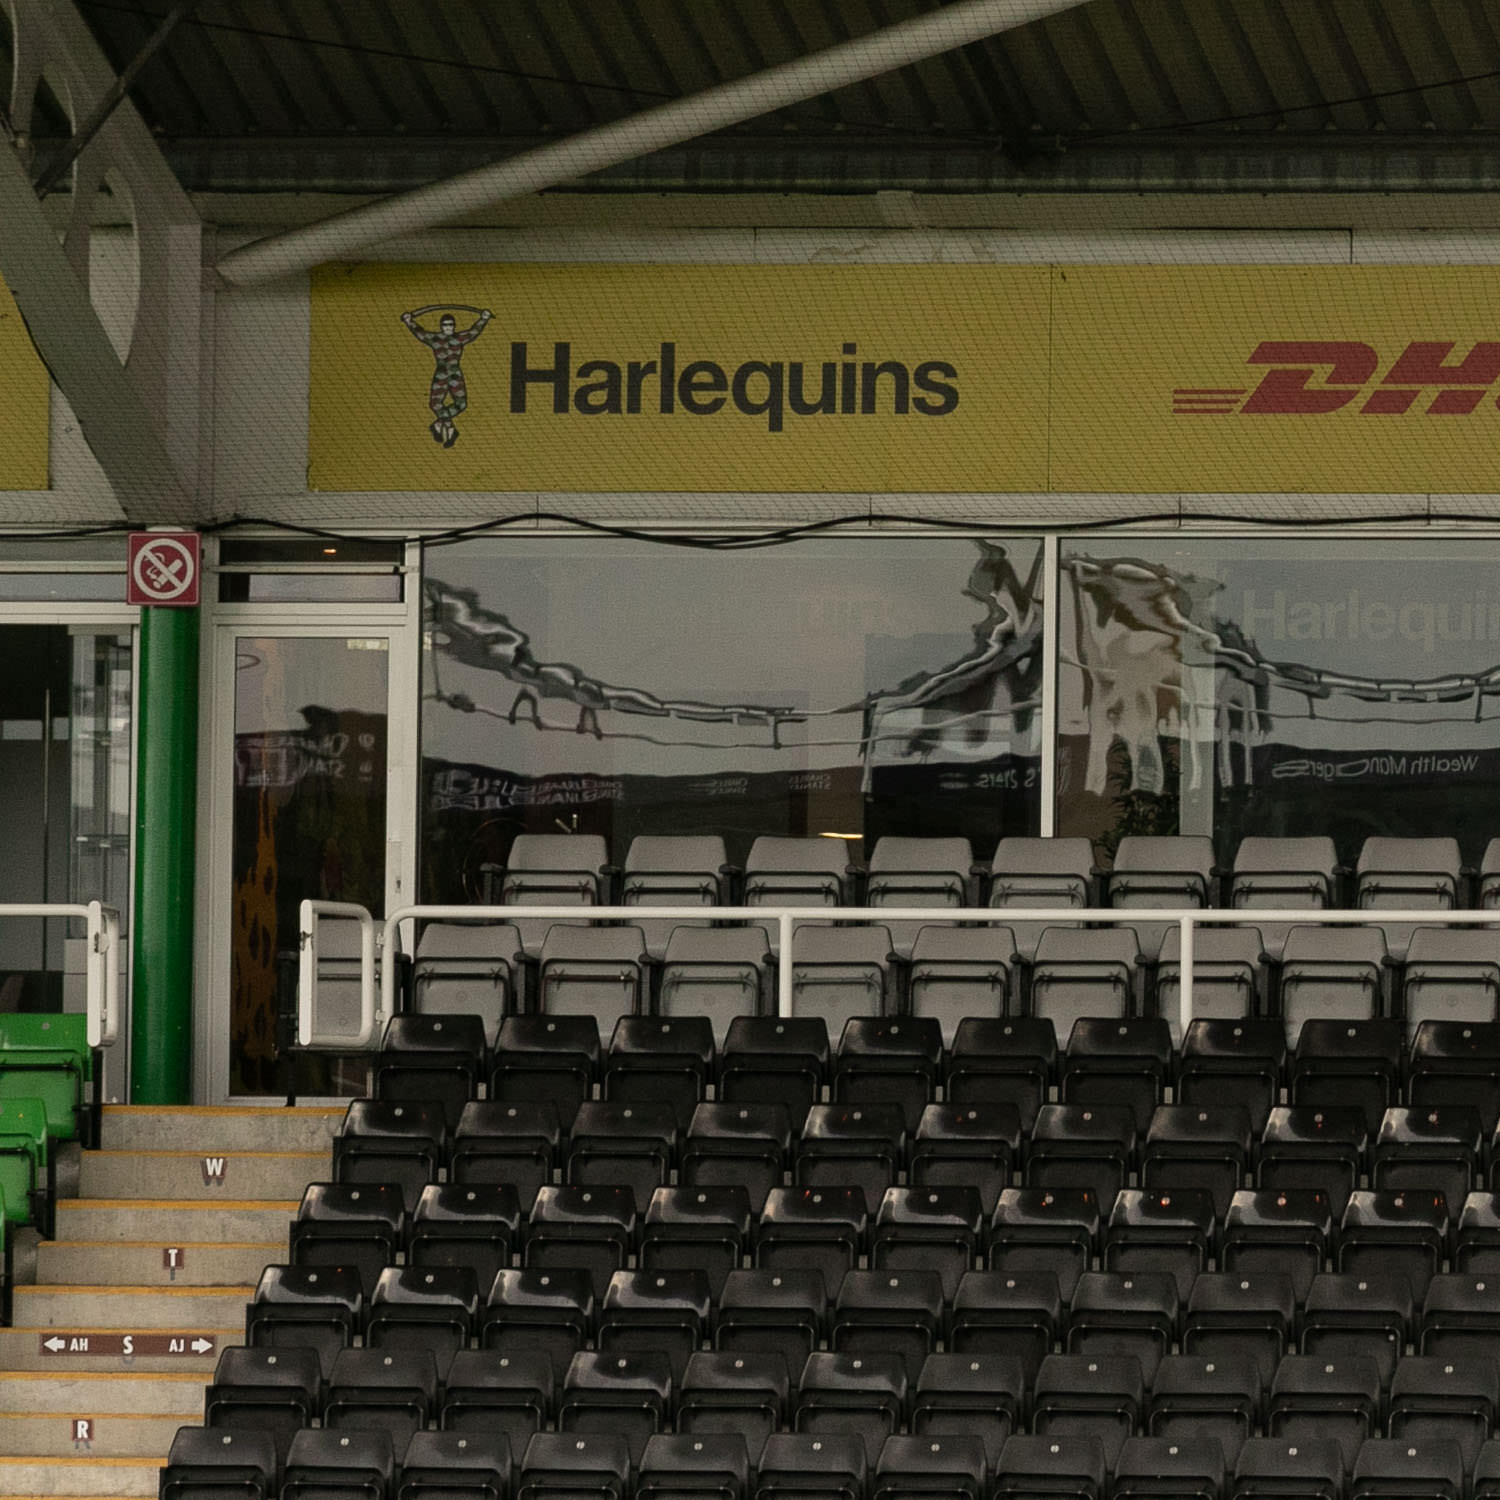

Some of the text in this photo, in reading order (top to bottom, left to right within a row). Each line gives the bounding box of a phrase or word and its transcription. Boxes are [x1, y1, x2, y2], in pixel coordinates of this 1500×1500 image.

[510, 342, 960, 432] Harlequins
[206, 1157, 224, 1177] W
[168, 1248, 179, 1267] T
[69, 1335, 186, 1355] AH S AJ
[77, 1420, 89, 1439] R
